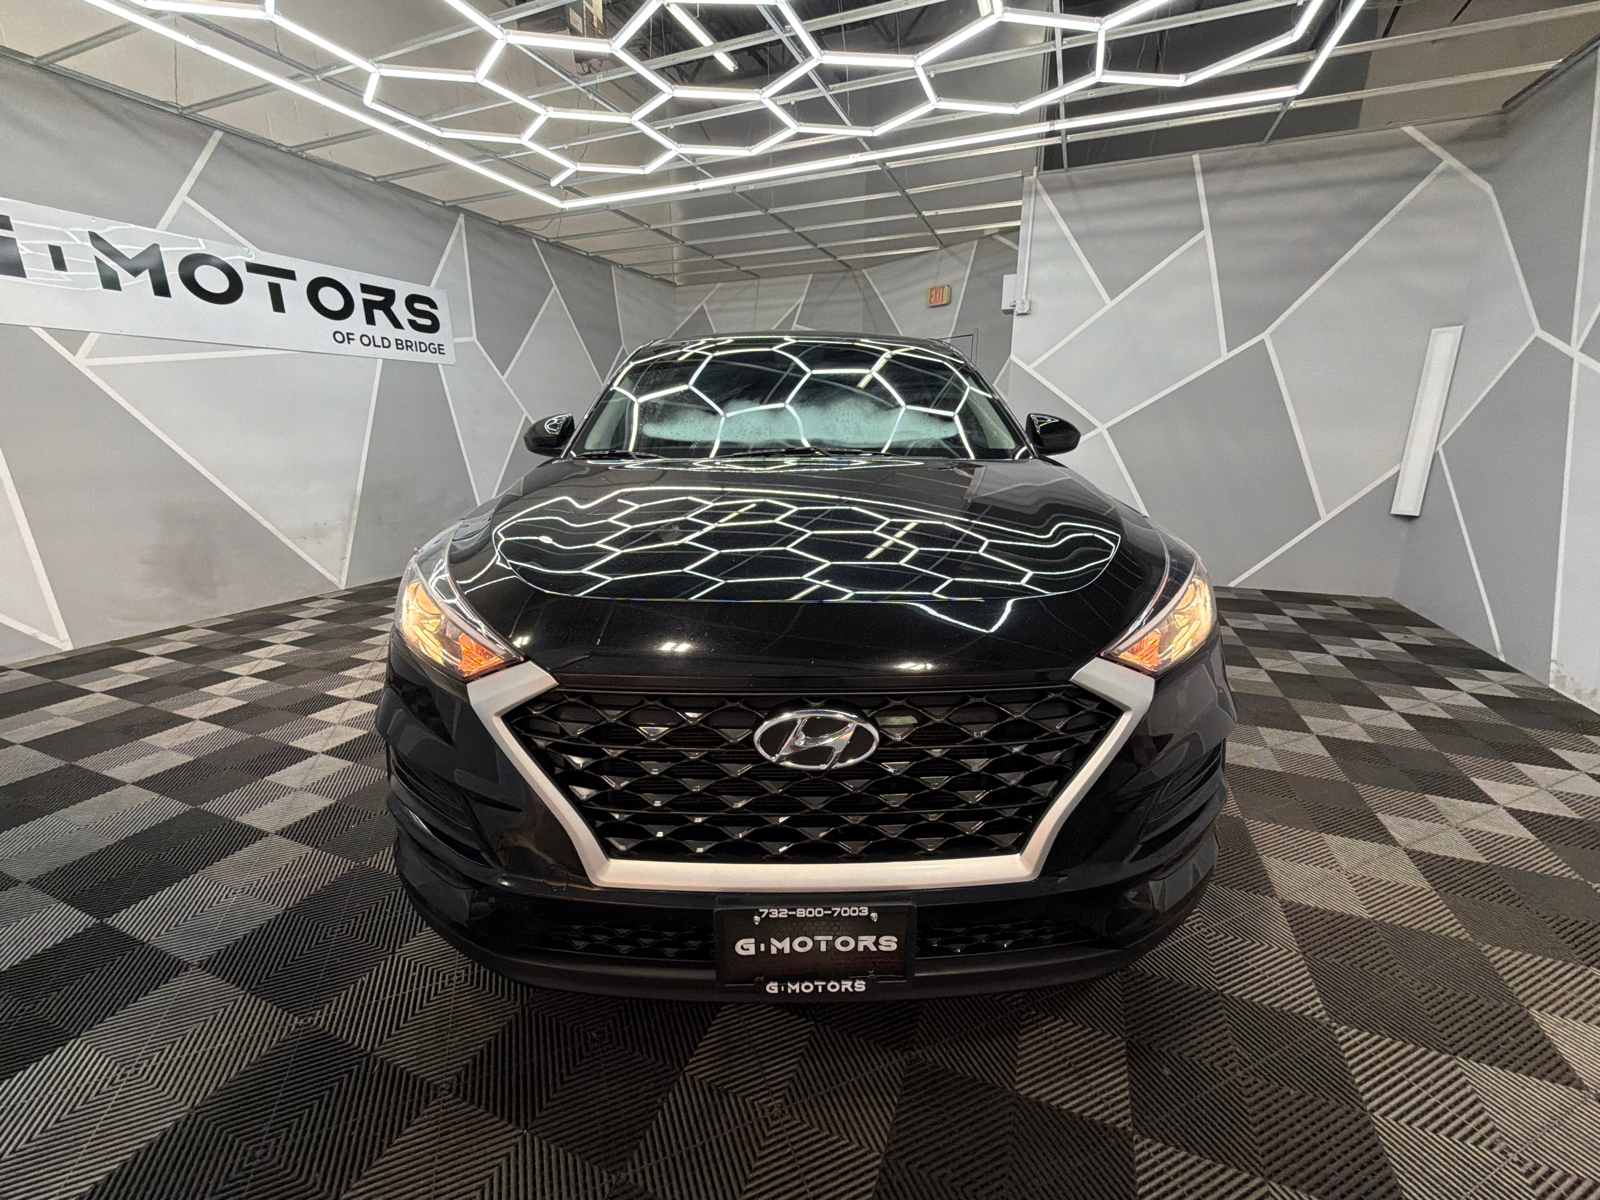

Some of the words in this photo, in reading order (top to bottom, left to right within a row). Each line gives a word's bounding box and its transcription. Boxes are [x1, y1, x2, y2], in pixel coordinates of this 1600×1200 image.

[929, 286, 946, 305] EXIT
[332, 330, 356, 345] OF
[359, 334, 392, 349] OLD
[394, 338, 446, 355] BRIDGE
[759, 906, 869, 919] 732-800-7003
